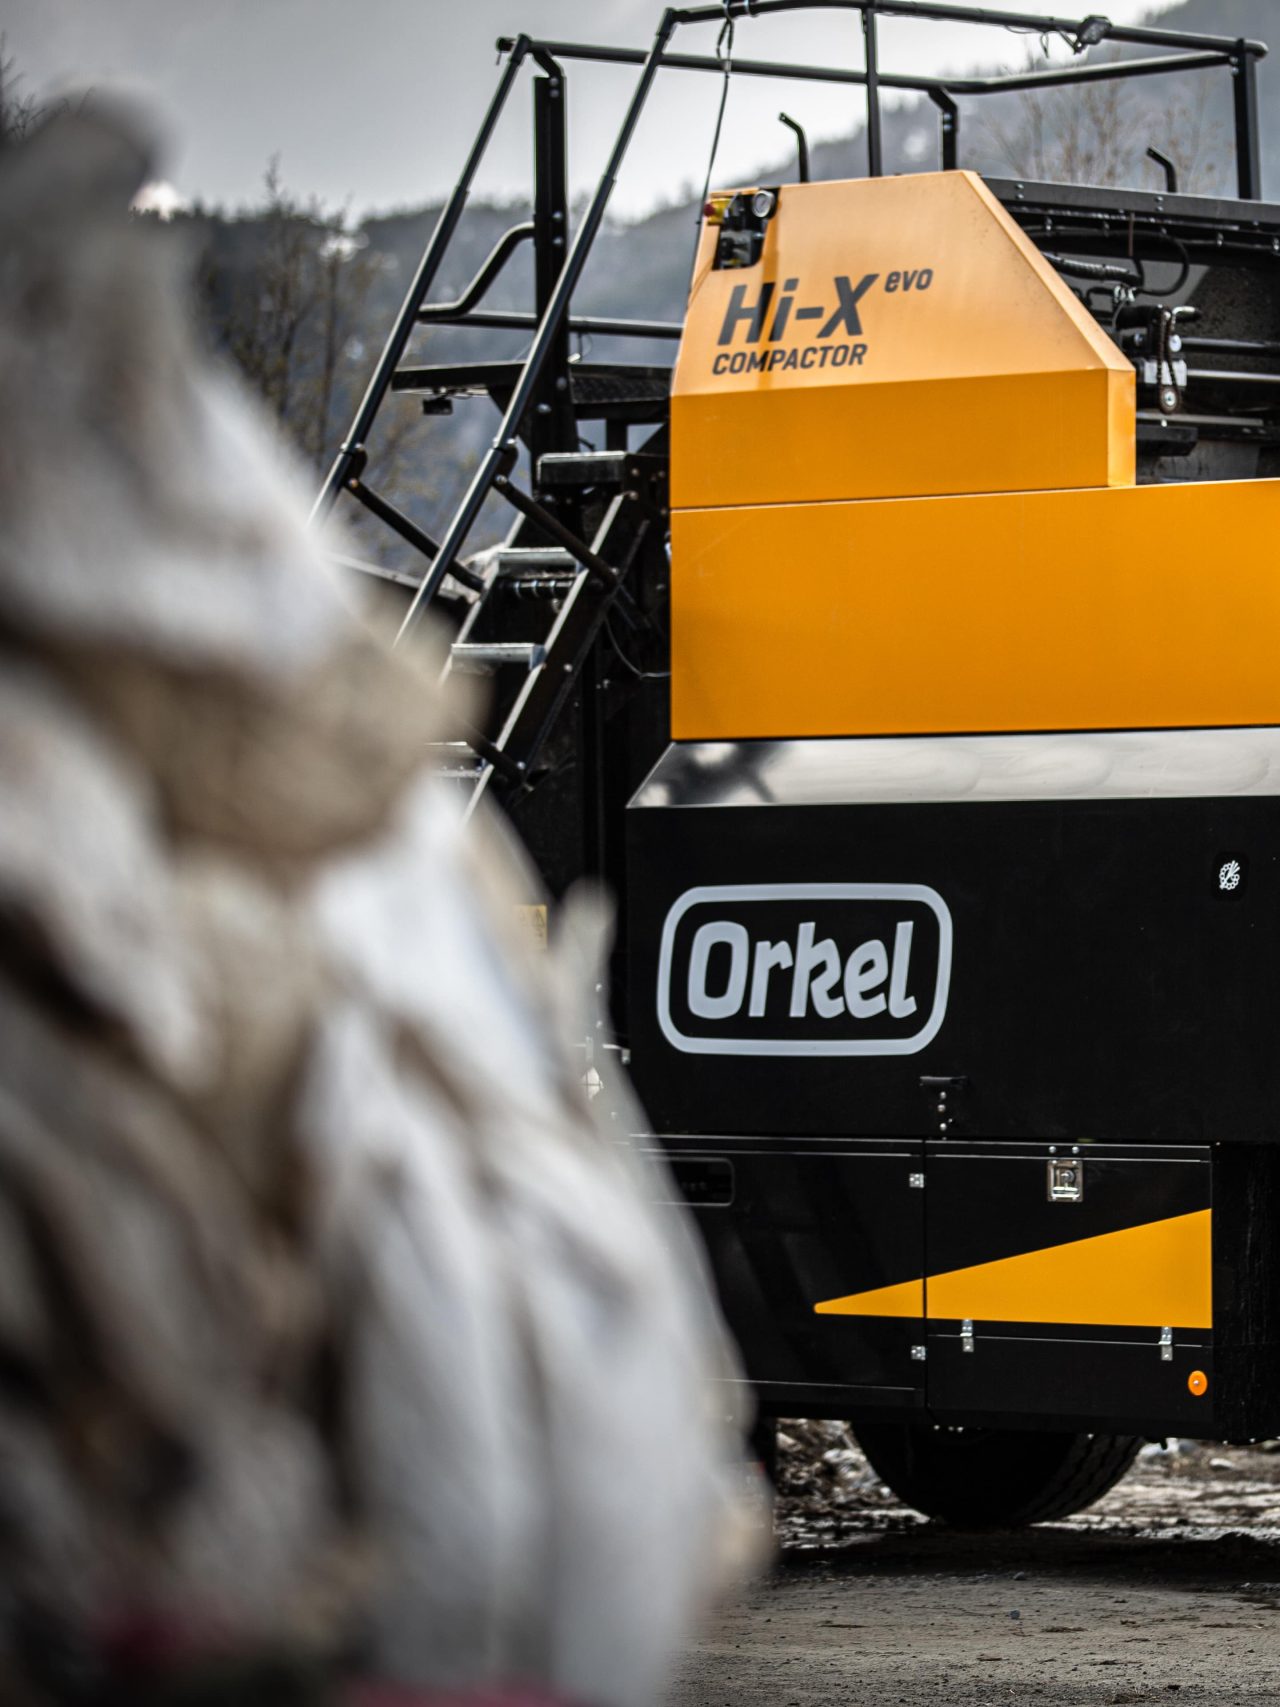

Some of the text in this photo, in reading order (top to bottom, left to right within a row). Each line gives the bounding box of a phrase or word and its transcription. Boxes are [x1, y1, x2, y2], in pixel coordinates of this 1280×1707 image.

[716, 268, 934, 346] Hi-X evo
[712, 343, 868, 376] COMPACTOR
[687, 920, 918, 1020] Orkel
